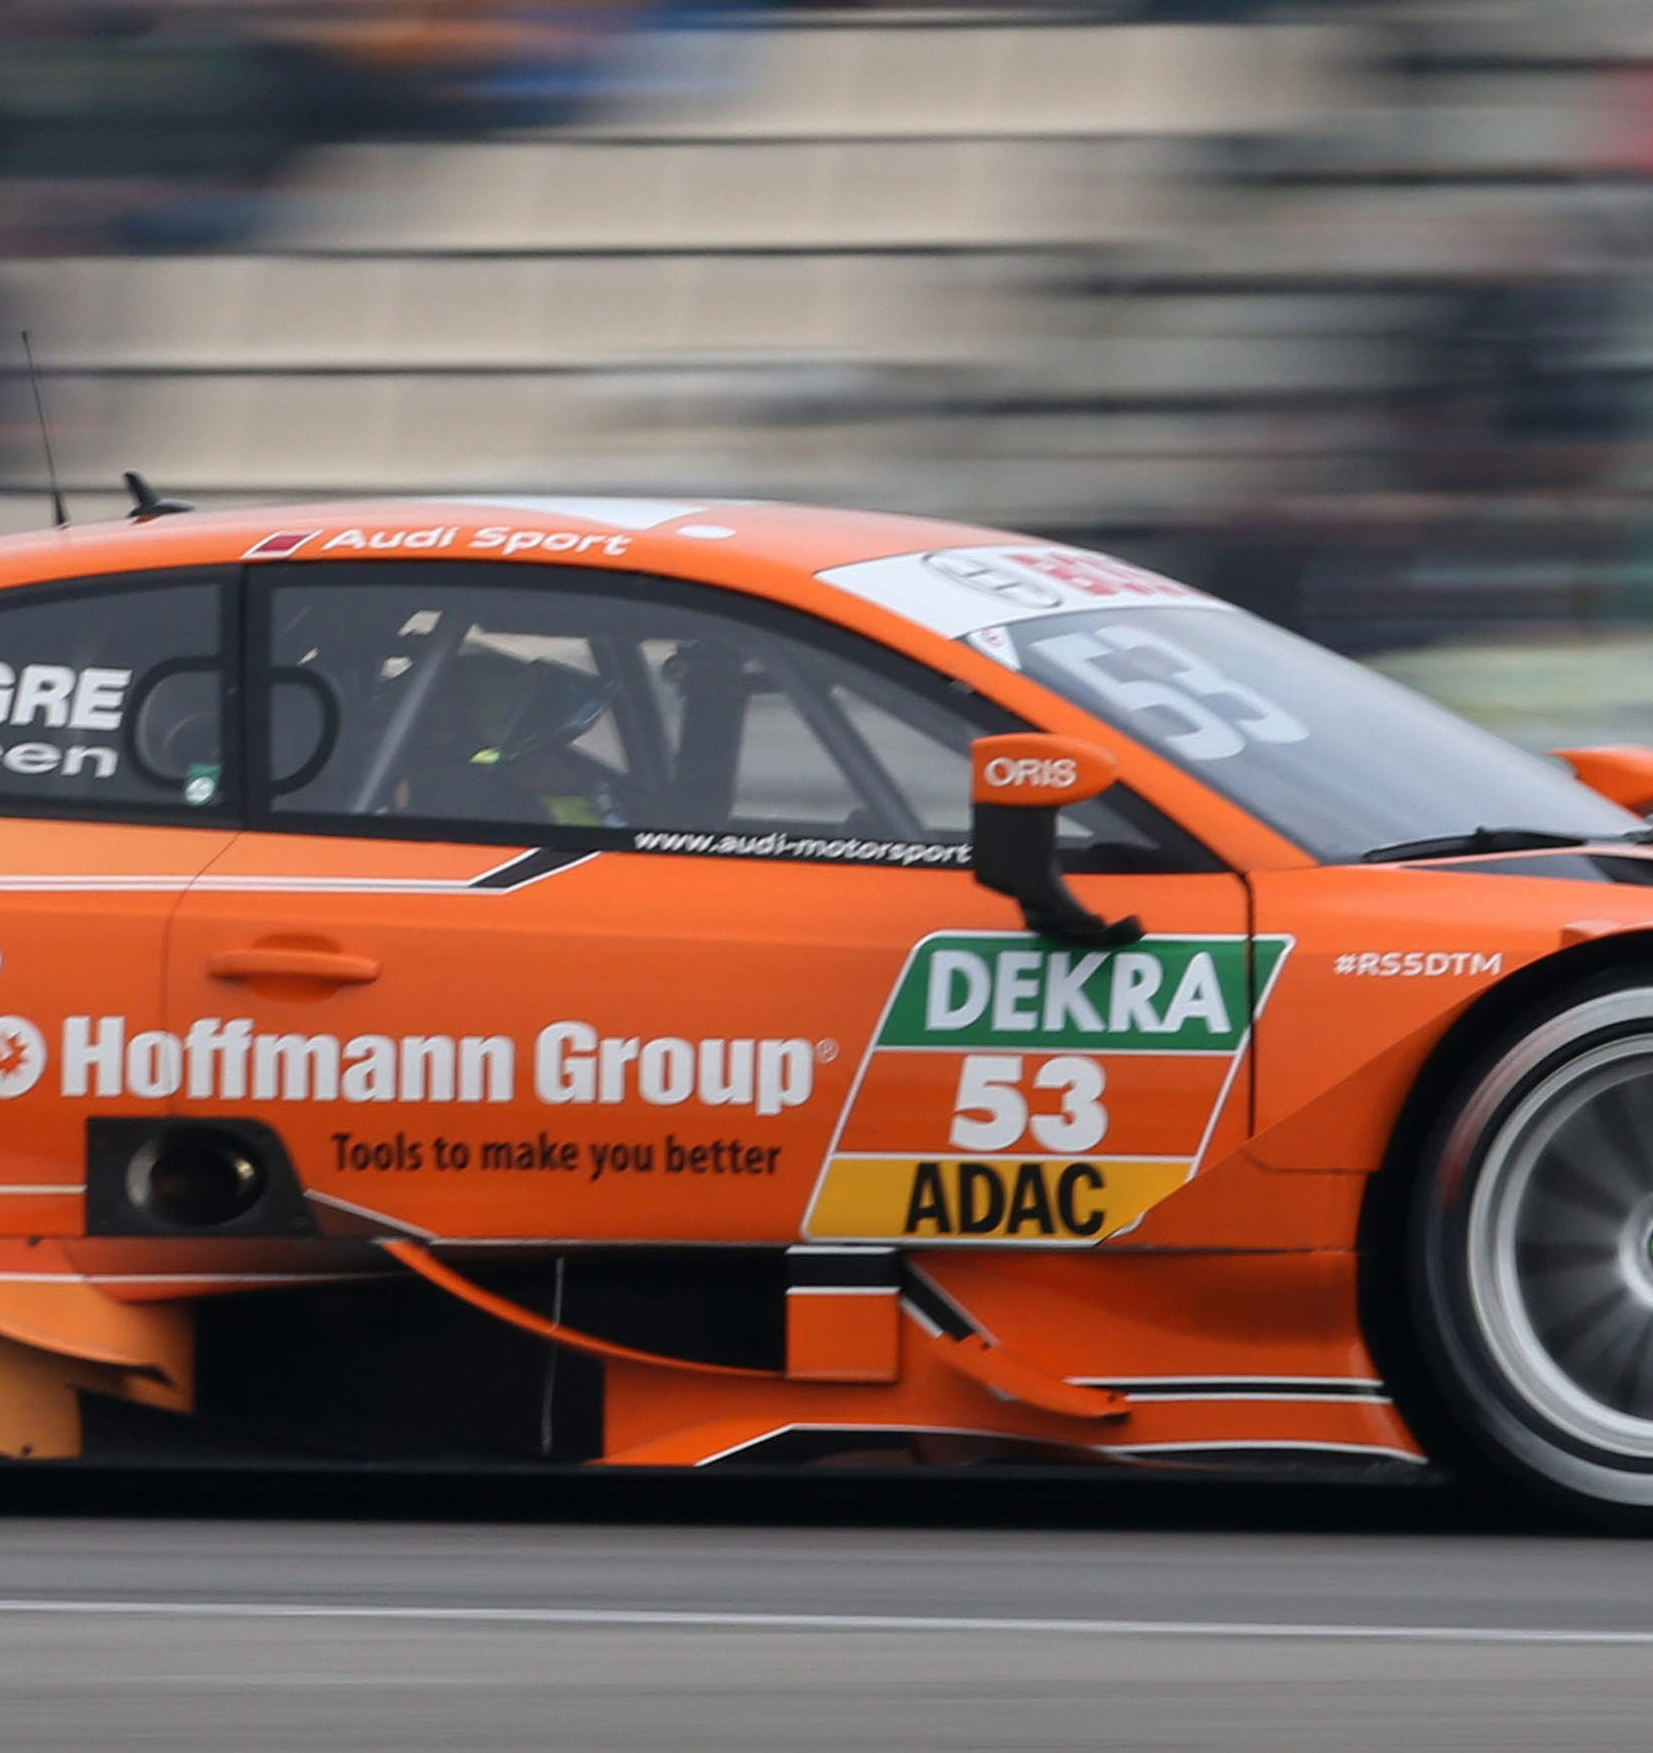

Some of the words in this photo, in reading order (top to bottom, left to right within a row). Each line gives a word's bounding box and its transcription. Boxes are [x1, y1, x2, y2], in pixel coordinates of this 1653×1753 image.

[322, 526, 459, 551] Audi
[468, 527, 633, 556] Sport
[983, 756, 1077, 789] ORIS
[924, 950, 1233, 1035] DEKRA
[60, 1015, 516, 1103] Hoffmann
[948, 1056, 1109, 1153] 53
[332, 1132, 423, 1173] Tools
[433, 1139, 470, 1172] to
[480, 1134, 580, 1174] make
[588, 1143, 652, 1181] you
[664, 1136, 781, 1177] better
[903, 1163, 1107, 1236] ADAC
